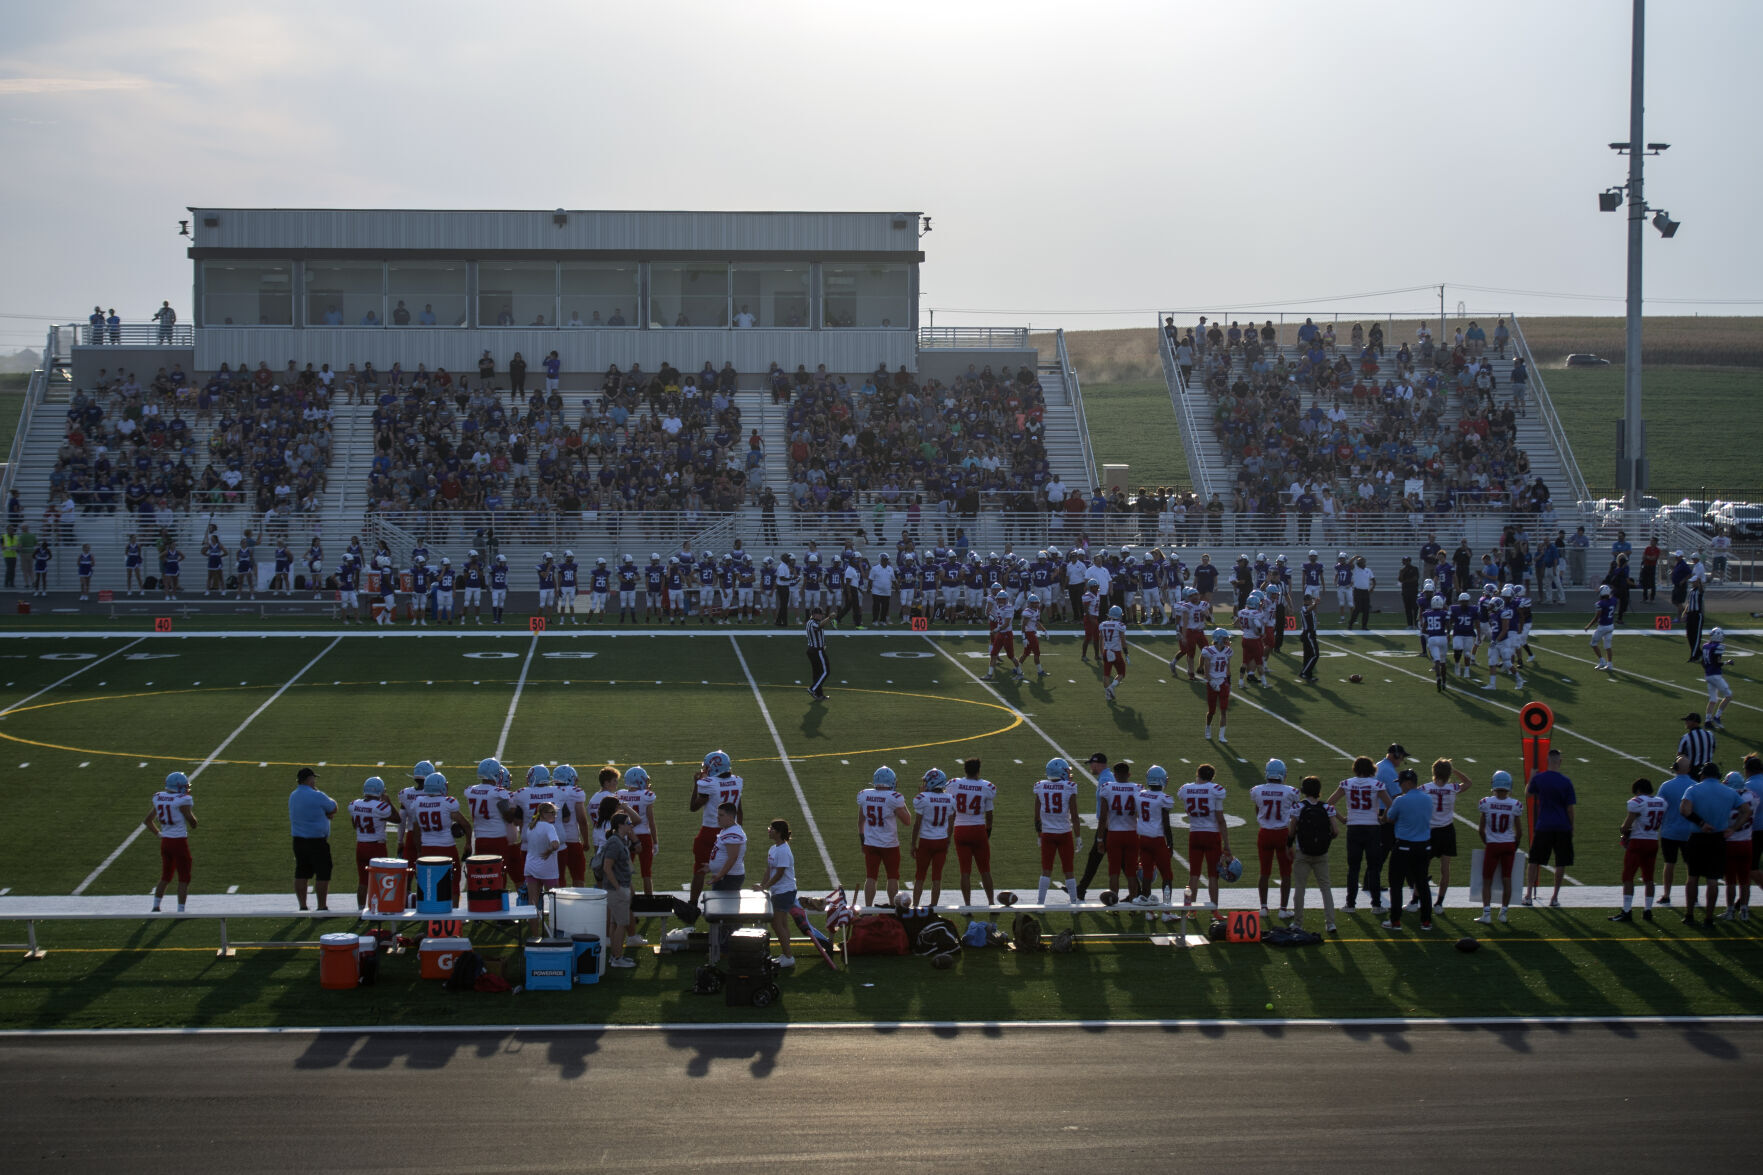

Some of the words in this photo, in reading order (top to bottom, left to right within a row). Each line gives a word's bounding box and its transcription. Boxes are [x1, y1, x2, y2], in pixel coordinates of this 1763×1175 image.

[157, 619, 169, 630] 40
[532, 619, 543, 630] 50
[915, 619, 926, 630] 40
[1658, 618, 1669, 629] 20
[1103, 630, 1114, 641] 17
[720, 790, 739, 803] 77
[956, 793, 982, 815] 84
[1043, 792, 1062, 813] 19
[1112, 795, 1136, 816] 44
[1350, 790, 1372, 810] 55
[1436, 793, 1443, 812] 1
[157, 804, 174, 825] 21
[468, 798, 490, 819] 74
[866, 805, 884, 826] 51
[932, 806, 947, 826] 11
[1187, 798, 1210, 817] 25
[1263, 800, 1281, 820] 71
[352, 815, 375, 834] 42
[419, 811, 443, 832] 99
[1491, 813, 1509, 833] 10
[382, 875, 394, 889] G
[431, 920, 455, 936] 50
[1233, 914, 1257, 939] 40
